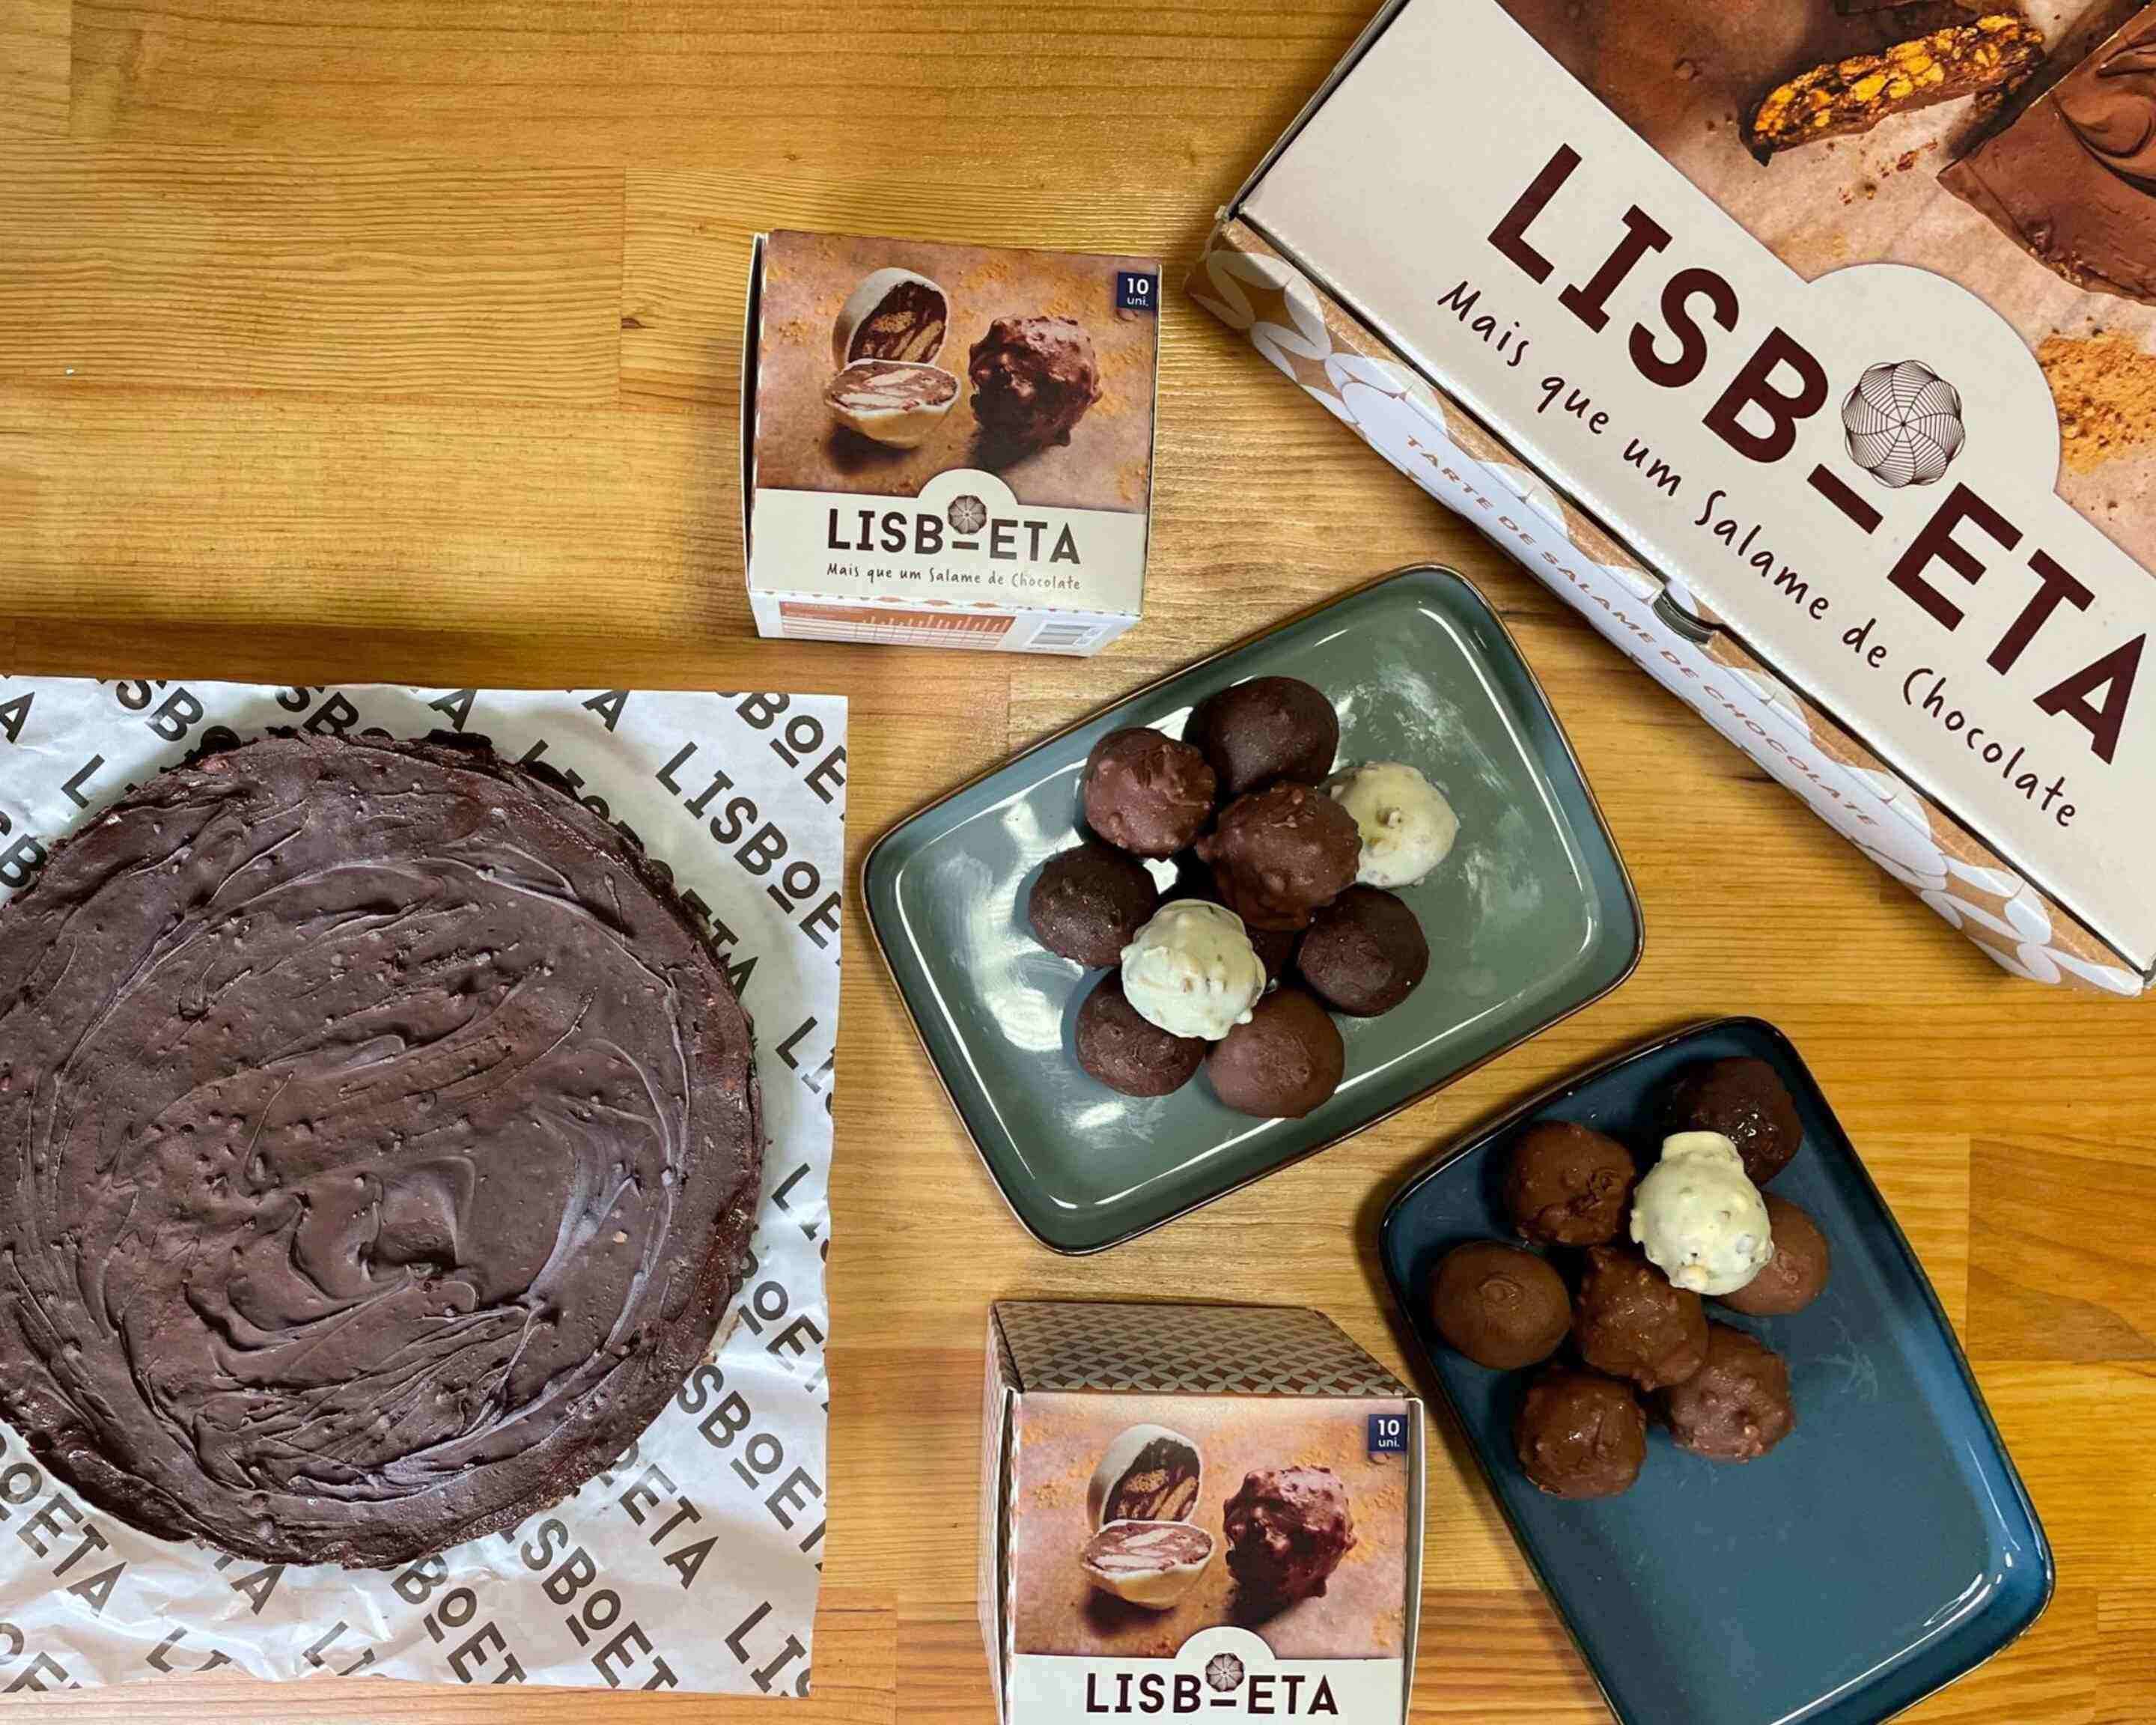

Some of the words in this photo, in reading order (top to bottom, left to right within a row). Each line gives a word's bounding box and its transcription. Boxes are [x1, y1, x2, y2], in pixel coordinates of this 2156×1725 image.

[1127, 278, 1149, 294] 10
[1127, 296, 1149, 306] uni.
[1437, 281, 1529, 367] Mais
[1537, 377, 1610, 434] que
[1622, 438, 1682, 497] um
[1694, 490, 1829, 620] Salame
[1842, 618, 1887, 668] de
[1903, 668, 2076, 827] Chocolate
[826, 563, 859, 578] Mais
[867, 569, 892, 582] que
[900, 568, 922, 580] um
[929, 568, 981, 584] Salame
[988, 571, 1004, 585] de
[1011, 571, 1081, 591] Chocolate
[1408, 435, 1494, 510] TARTE
[1499, 515, 1537, 547] DE
[1541, 550, 1657, 643] SALAME
[1660, 651, 1699, 678] DE
[1703, 685, 1880, 827] CHOCOLATE
[655, 741, 842, 962] LISBOE
[1377, 1420, 1400, 1436] 10
[1378, 1437, 1400, 1447] uni.
[494, 1518, 678, 1690] SBOET
